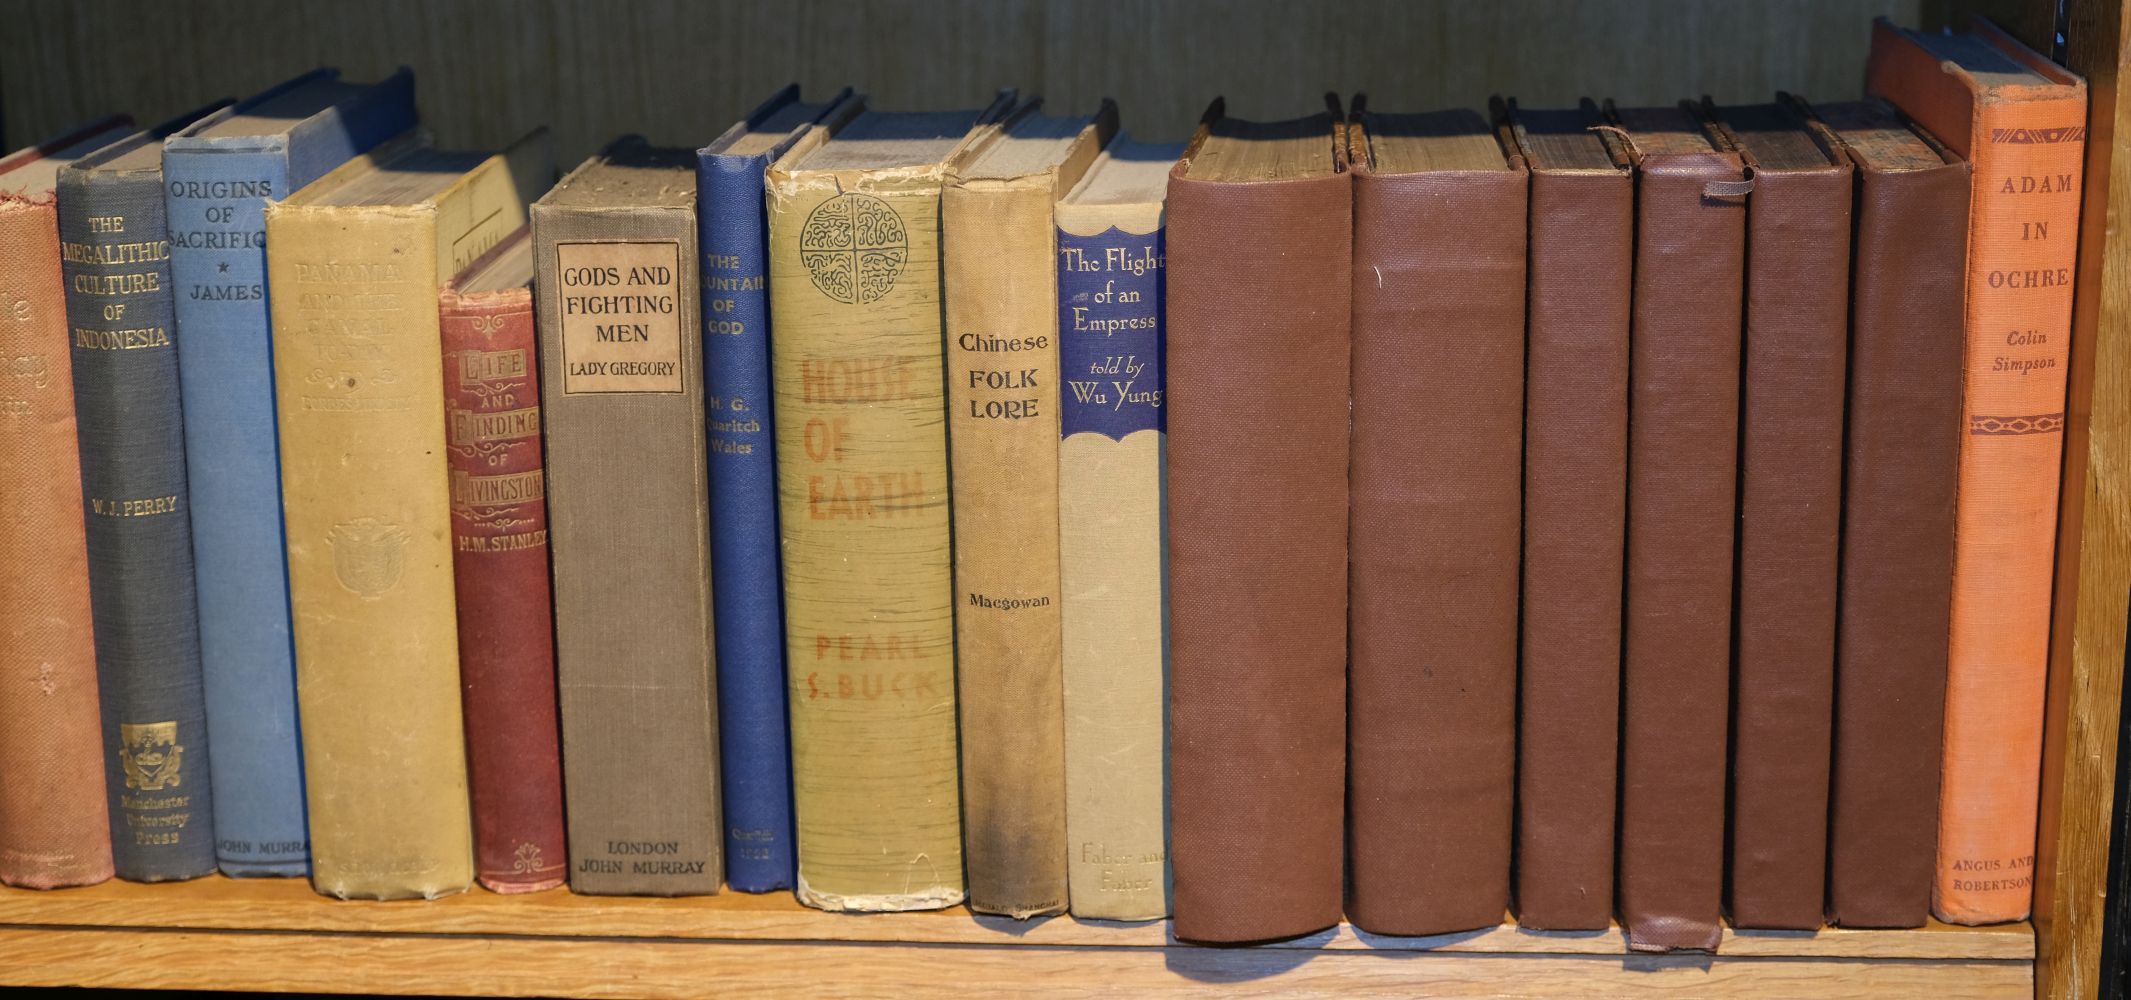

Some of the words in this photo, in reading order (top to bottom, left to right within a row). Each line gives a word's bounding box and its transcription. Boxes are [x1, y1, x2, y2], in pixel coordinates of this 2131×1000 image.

[170, 180, 273, 199] ORIGINS
[2000, 174, 2073, 194] ADAM
[88, 217, 125, 233] THE
[204, 206, 235, 224] OF
[167, 230, 266, 250] SACRIFIC
[2021, 221, 2049, 241] IN
[63, 240, 170, 265] MEGALITHIC
[707, 254, 740, 269] THE
[1061, 248, 1100, 272] The
[1105, 246, 1166, 276] Flight
[74, 272, 160, 295] CULTURE
[295, 262, 404, 285] PANAMA
[564, 267, 620, 287] GODS
[627, 266, 671, 286] AND
[1987, 268, 2070, 289] OCHRE
[189, 284, 264, 301] JAMES
[1094, 280, 1115, 304] of
[1118, 291, 1141, 303] an
[103, 304, 125, 321] OF
[567, 296, 673, 315] FIGHTING
[712, 299, 735, 313] OF
[708, 320, 745, 335] GOD
[1072, 306, 1156, 337] Empress
[76, 328, 170, 350] INDONESIA
[596, 324, 649, 343] MEN
[959, 333, 1049, 352] Chinese
[2006, 330, 2047, 347] Colin
[463, 352, 523, 381] LIFE
[570, 362, 607, 376] LADY
[610, 362, 676, 376] GREGORY
[1090, 356, 1123, 375] told
[1126, 355, 1145, 379] by
[1992, 356, 2057, 375] Simpson
[802, 357, 918, 405] HOUSE
[969, 368, 1039, 389] FOLK
[481, 394, 515, 409] AND
[1068, 380, 1108, 404] Wu
[1112, 380, 1163, 412] Yung
[970, 398, 1039, 419] LORE
[454, 411, 538, 442] FINDING
[711, 439, 753, 455] Wales
[803, 417, 851, 463] OF
[488, 454, 508, 467] OF
[456, 474, 542, 504] LIVINGSTON
[808, 470, 926, 521] EARTH
[970, 593, 1050, 611] Macgowan
[815, 634, 929, 661] PEARL
[135, 832, 181, 845] Press
[217, 839, 251, 854] JOHN
[607, 841, 679, 855] LONDON
[1081, 842, 1133, 865] Faber
[1952, 859, 2001, 871] ANGUS
[2008, 855, 2034, 869] AND
[579, 859, 623, 874] JOHN
[632, 861, 706, 876] MURRAY
[1098, 869, 1153, 892] Faber
[1953, 875, 2033, 892] ROBERTSON
